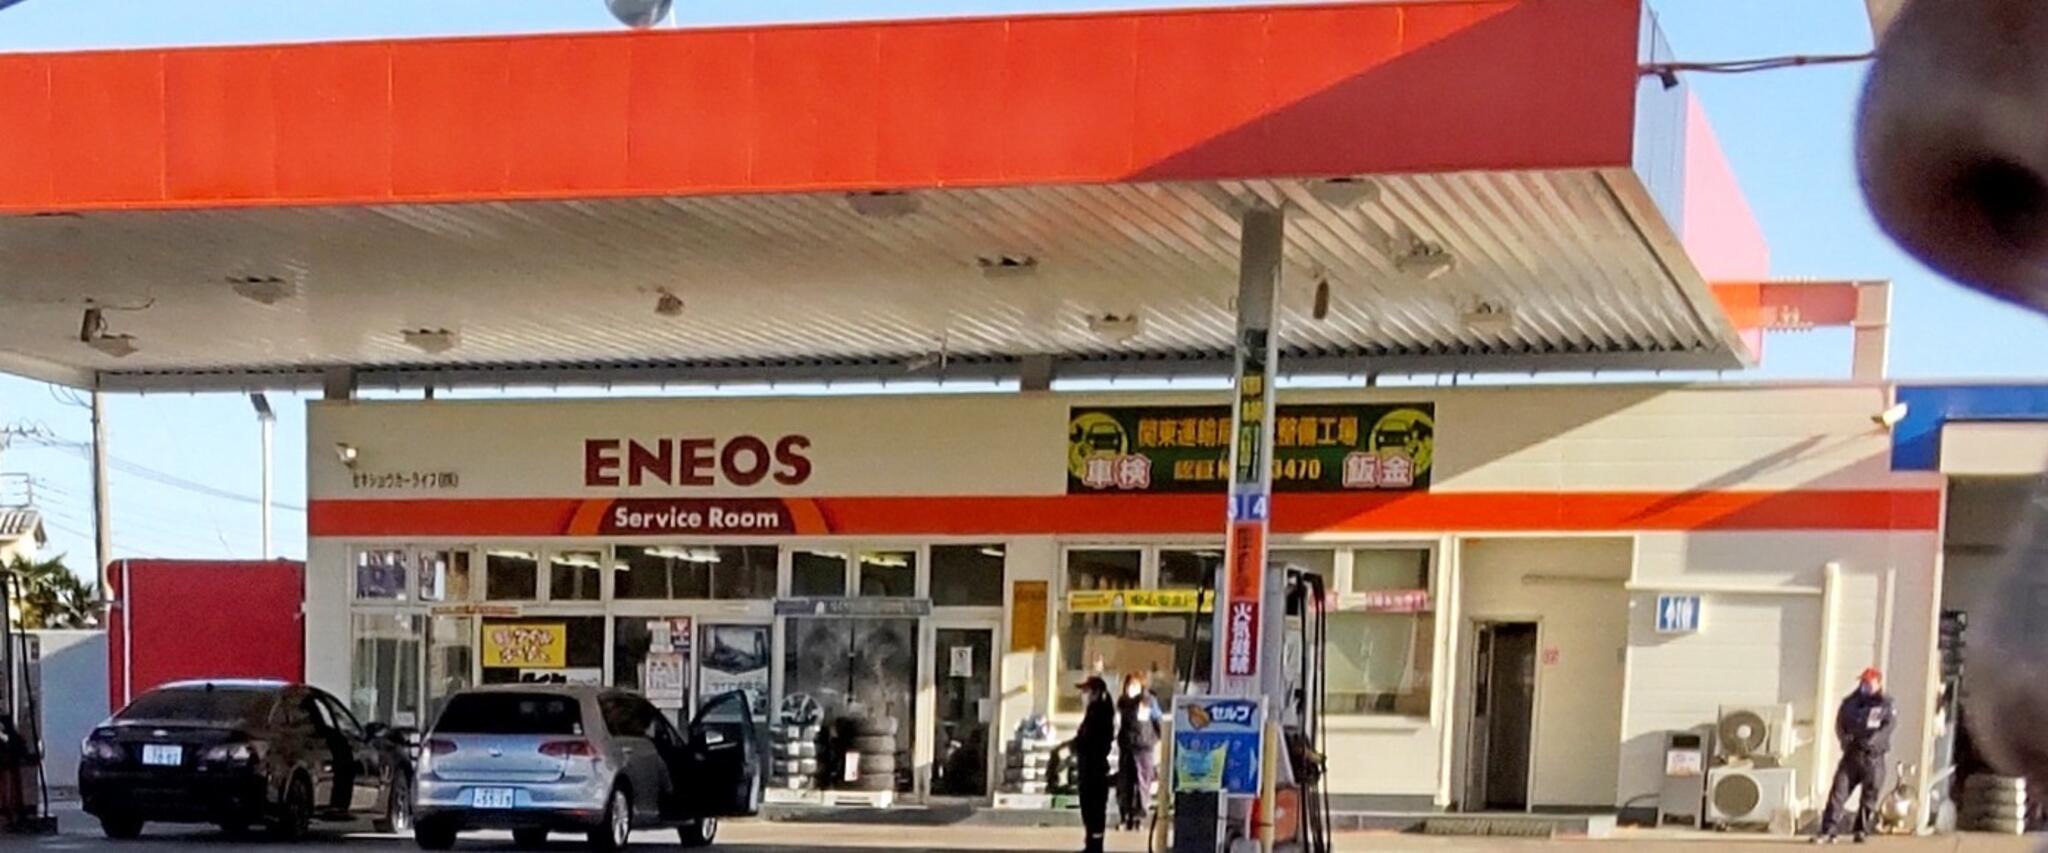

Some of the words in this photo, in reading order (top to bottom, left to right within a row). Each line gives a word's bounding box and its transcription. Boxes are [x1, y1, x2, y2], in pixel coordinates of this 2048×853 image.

[1138, 417, 1358, 447] 関東運輸局整備工場
[584, 434, 812, 488] ENEOS
[1086, 455, 1149, 487] 車検
[1346, 454, 1410, 485] 鈑金
[615, 506, 703, 530] Service
[709, 507, 779, 529] Room
[1252, 496, 1267, 518] 4
[1229, 602, 1252, 675] 火気厳禁
[1210, 705, 1251, 721] セルフ
